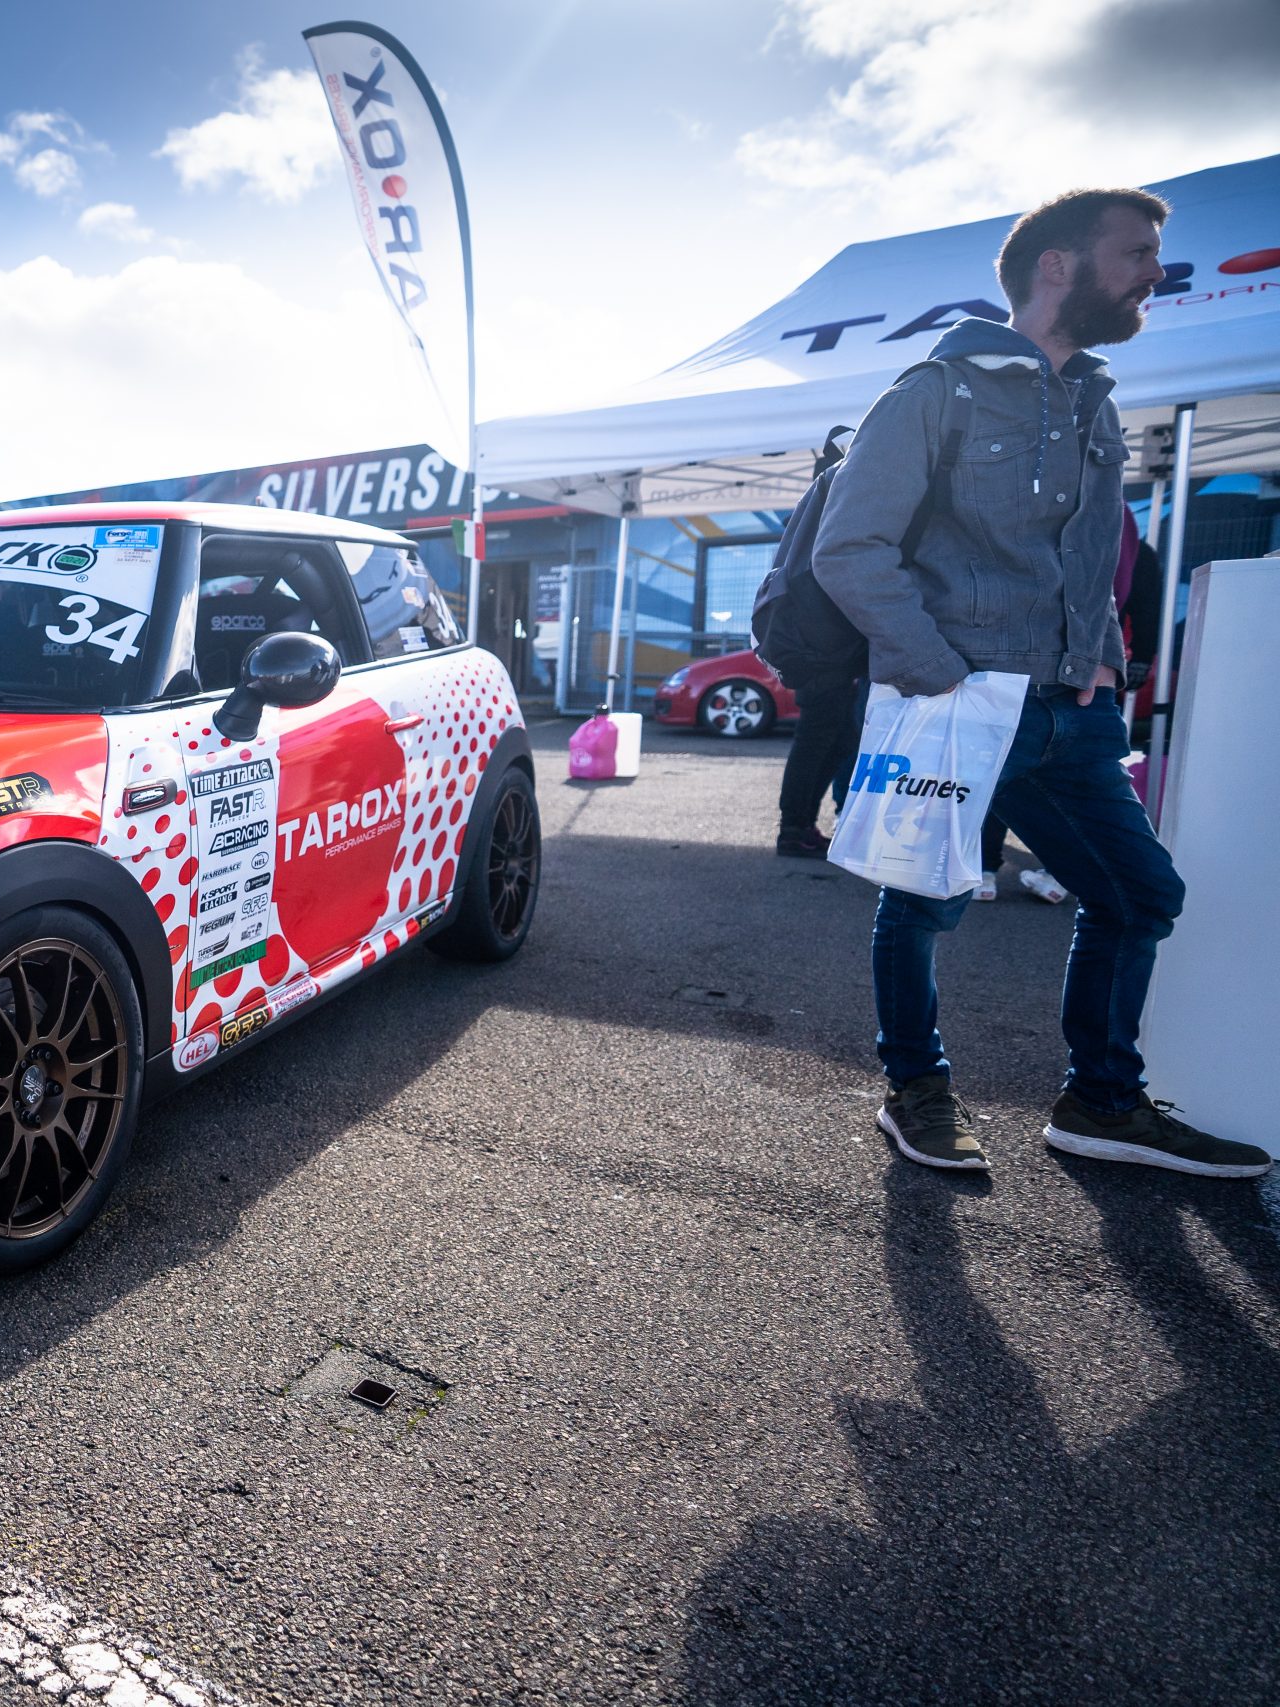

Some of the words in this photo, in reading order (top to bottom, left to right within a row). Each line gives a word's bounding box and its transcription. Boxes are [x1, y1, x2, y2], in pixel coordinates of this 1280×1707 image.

[45, 594, 149, 665] 34
[235, 821, 268, 844] RACING
[325, 829, 377, 859] PERFORMANCE
[377, 817, 402, 836] BRAKES
[254, 858, 266, 867] HEL
[208, 881, 239, 898] SPORT
[204, 892, 233, 911] RACING
[186, 1044, 210, 1064] HEL
